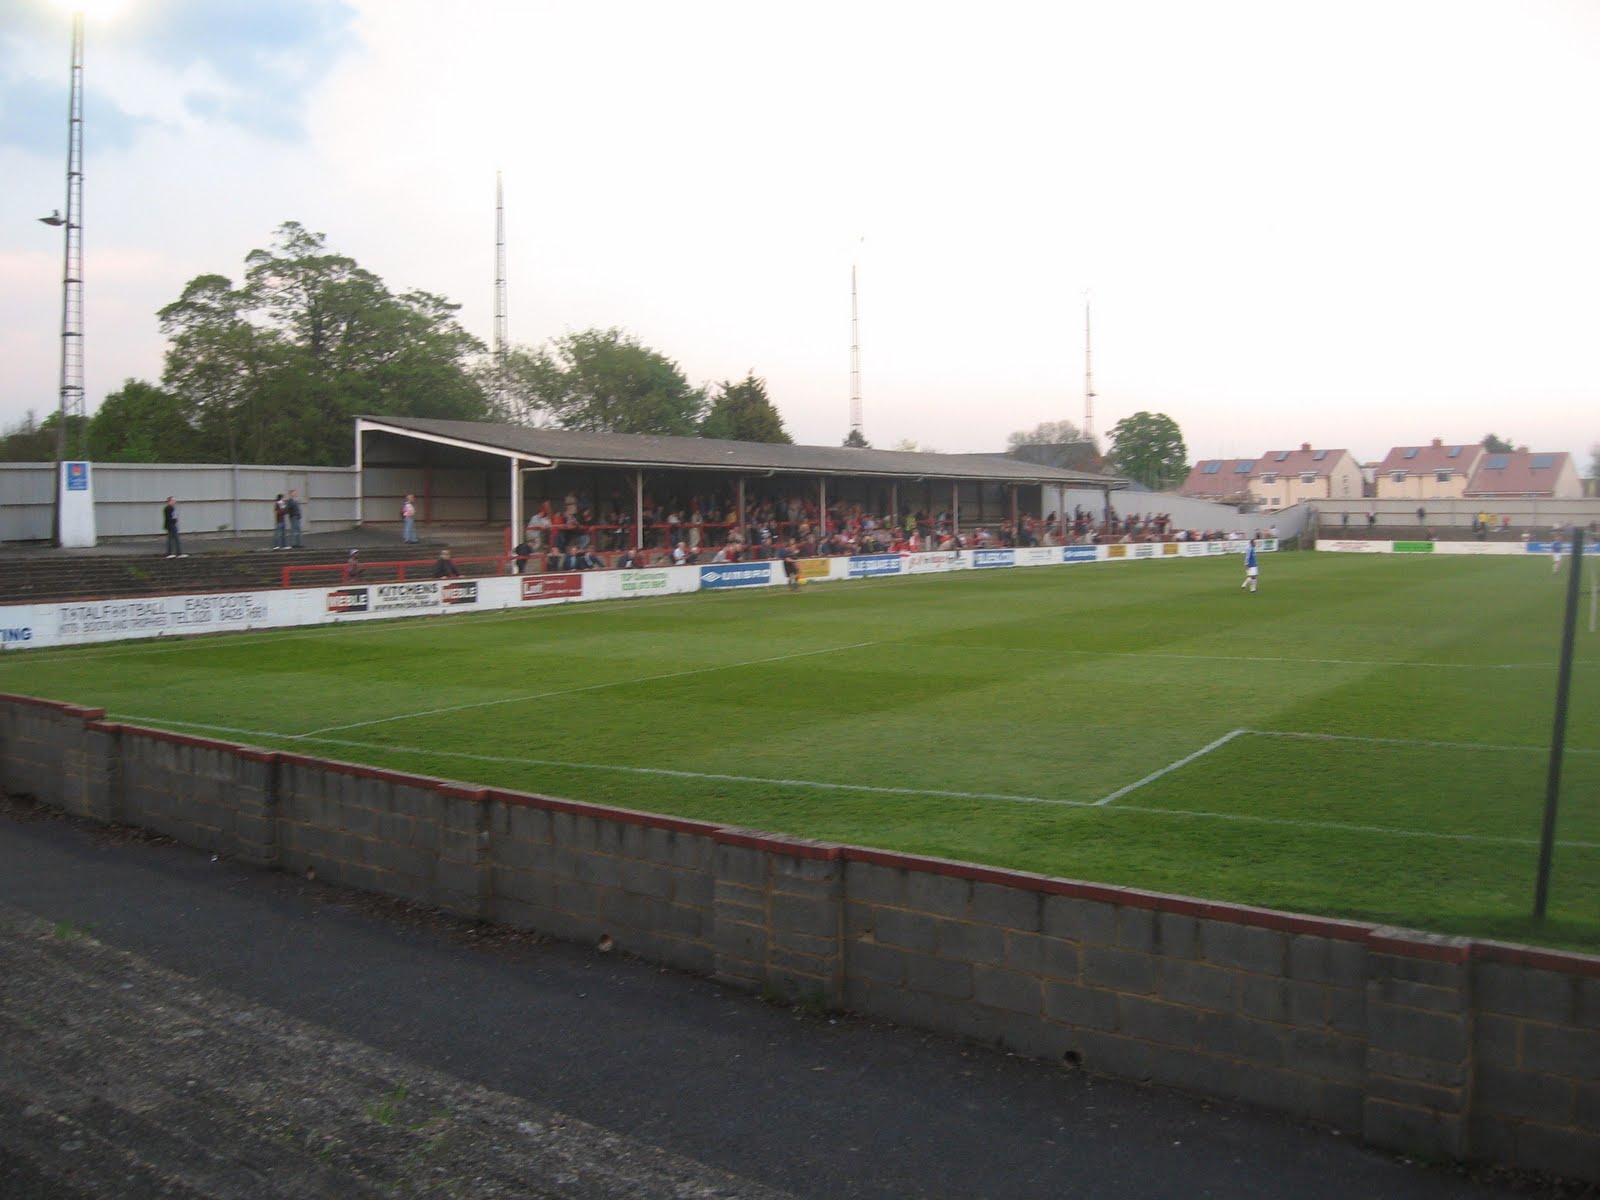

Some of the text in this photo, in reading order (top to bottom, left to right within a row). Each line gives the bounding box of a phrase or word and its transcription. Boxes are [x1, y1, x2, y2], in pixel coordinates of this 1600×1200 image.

[377, 583, 438, 597] KITCHENS
[442, 587, 477, 600] MEBLE
[185, 595, 252, 610] EASTCOTE
[326, 594, 368, 608] MEBLE
